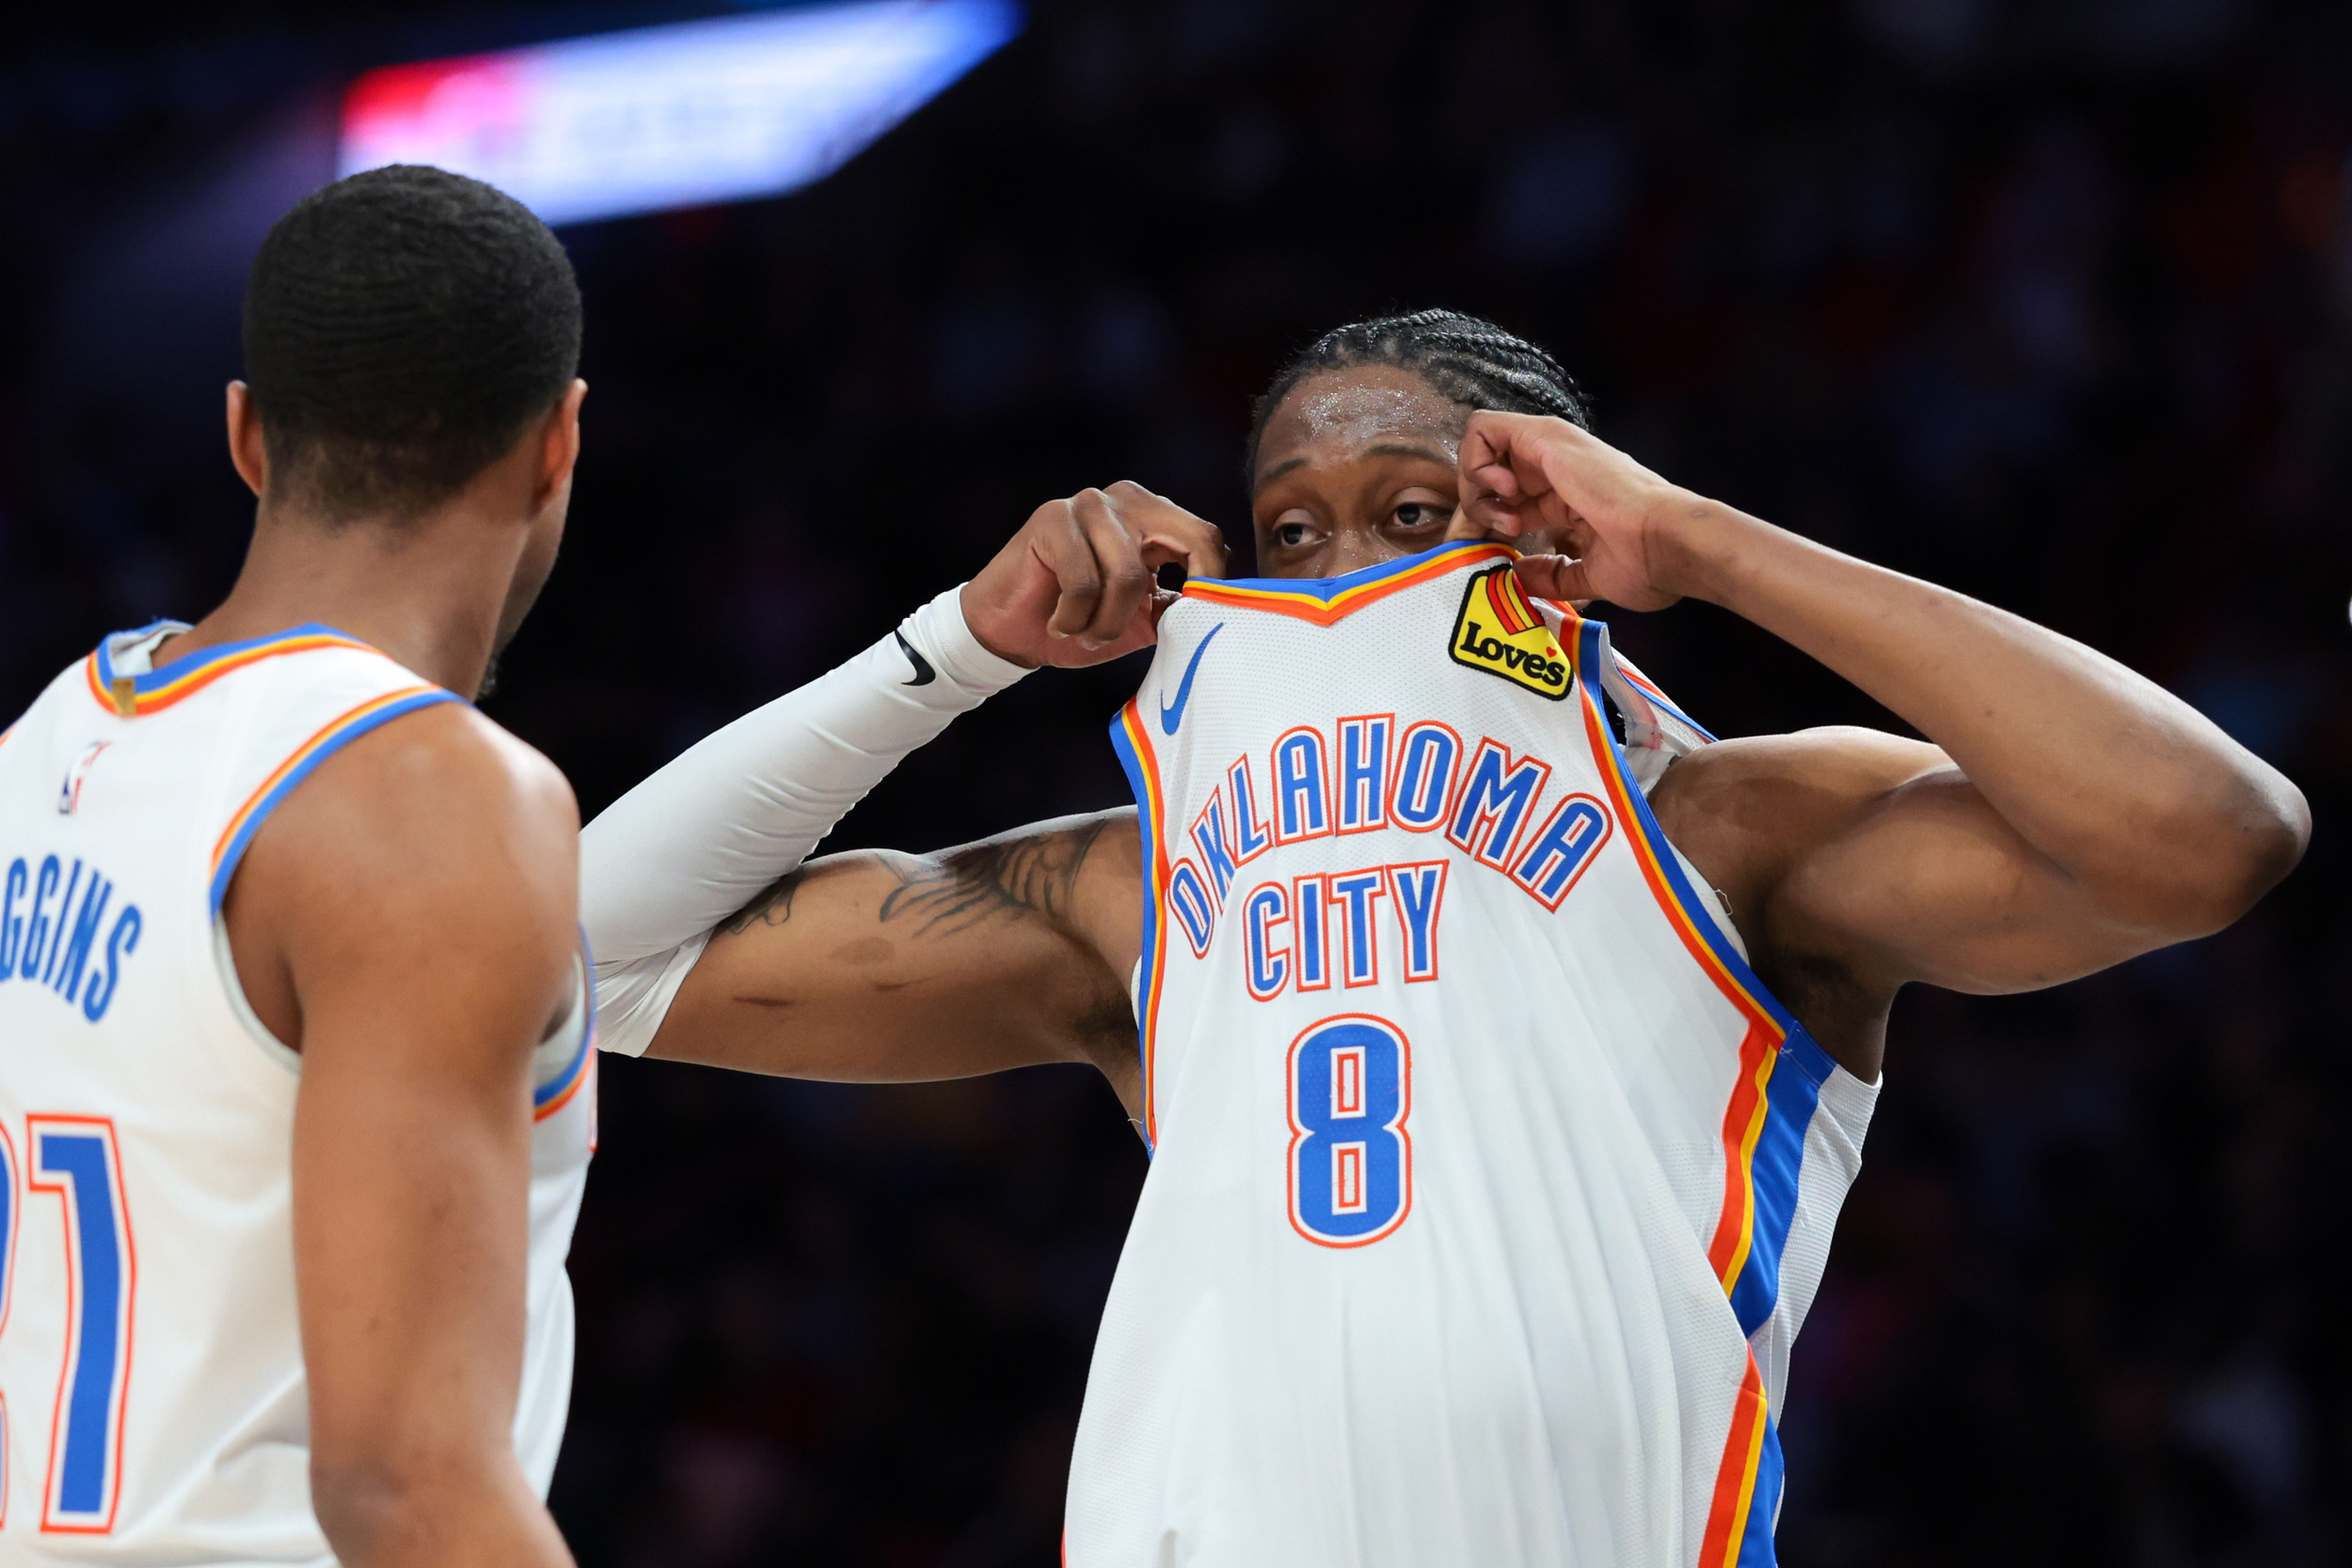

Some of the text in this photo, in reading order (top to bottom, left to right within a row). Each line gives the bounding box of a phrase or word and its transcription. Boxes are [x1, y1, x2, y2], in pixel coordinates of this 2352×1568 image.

[0, 853, 142, 1023] GGINS
[1167, 712, 1613, 959] OKLAHOMA
[1243, 859, 1450, 1002] CITY
[1286, 1012, 1411, 1249] 8
[0, 1113, 137, 1535] 1
